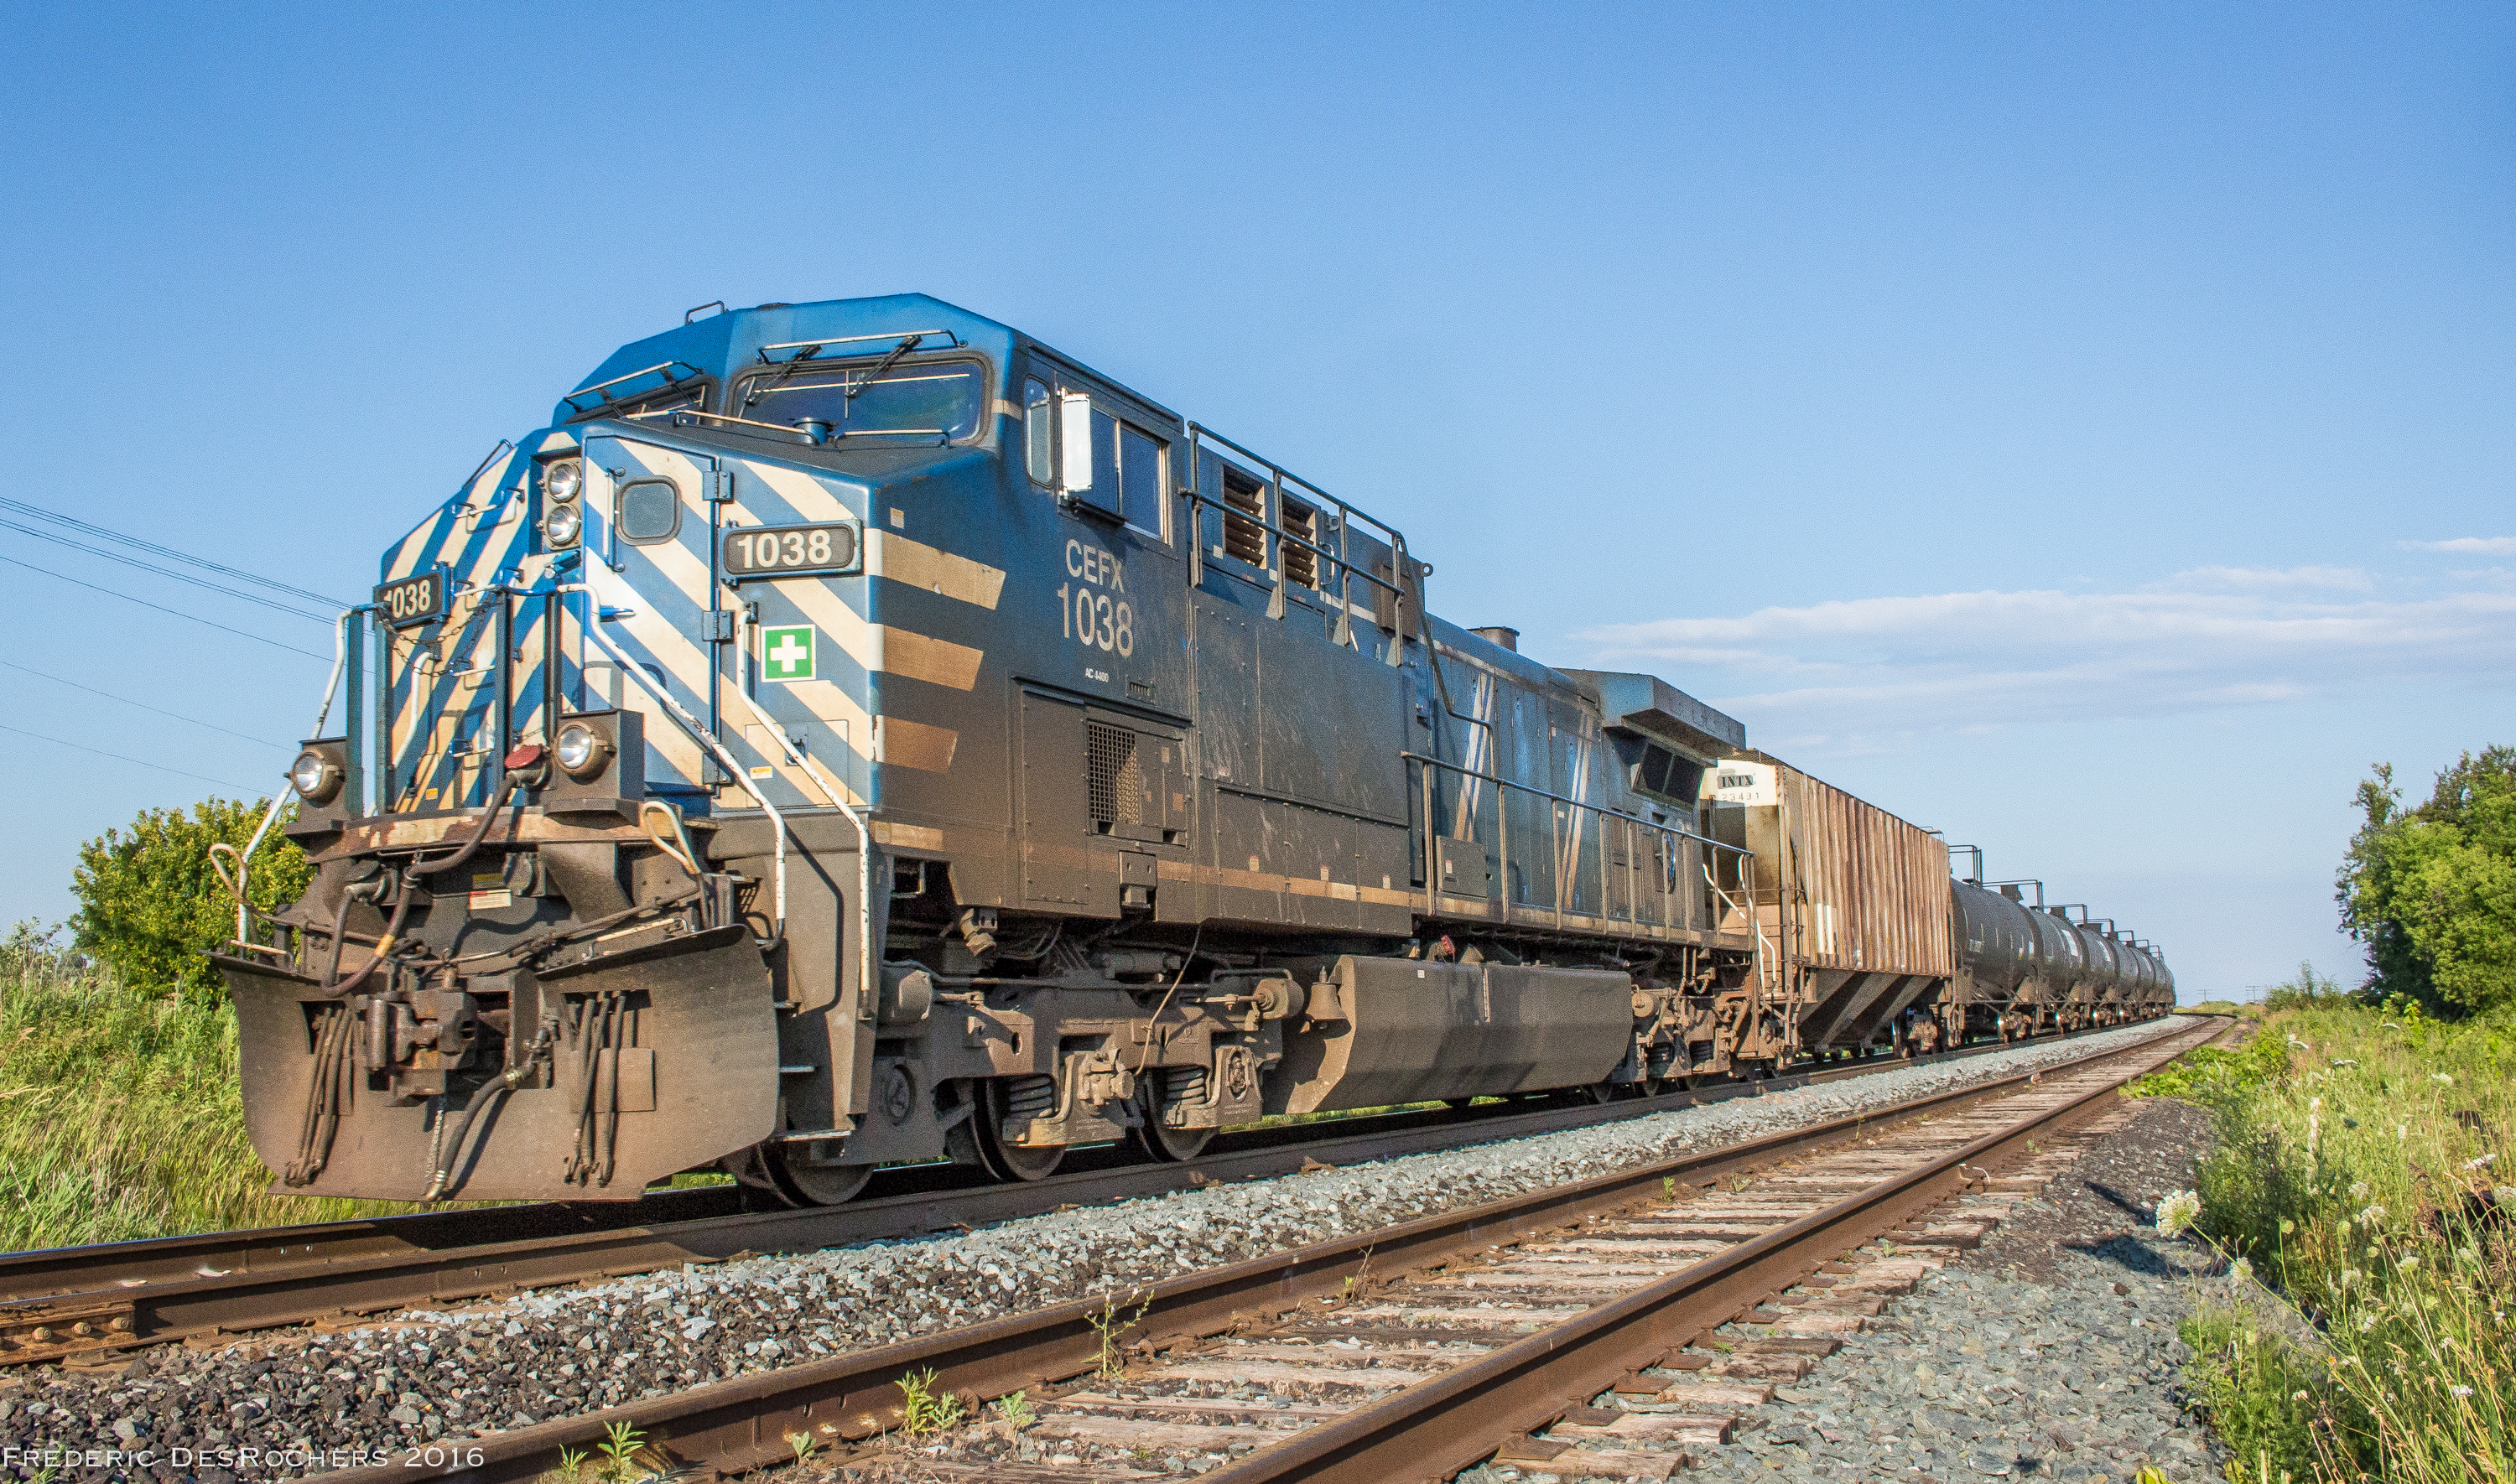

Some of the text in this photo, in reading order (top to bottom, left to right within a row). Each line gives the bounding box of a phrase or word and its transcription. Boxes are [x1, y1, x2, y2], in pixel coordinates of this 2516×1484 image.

[737, 530, 832, 568] 1038
[1066, 539, 1125, 594] CEFX
[1057, 582, 1133, 656] 1038
[1084, 667, 1110, 682] AC 4400
[1721, 775, 1754, 787] INTX
